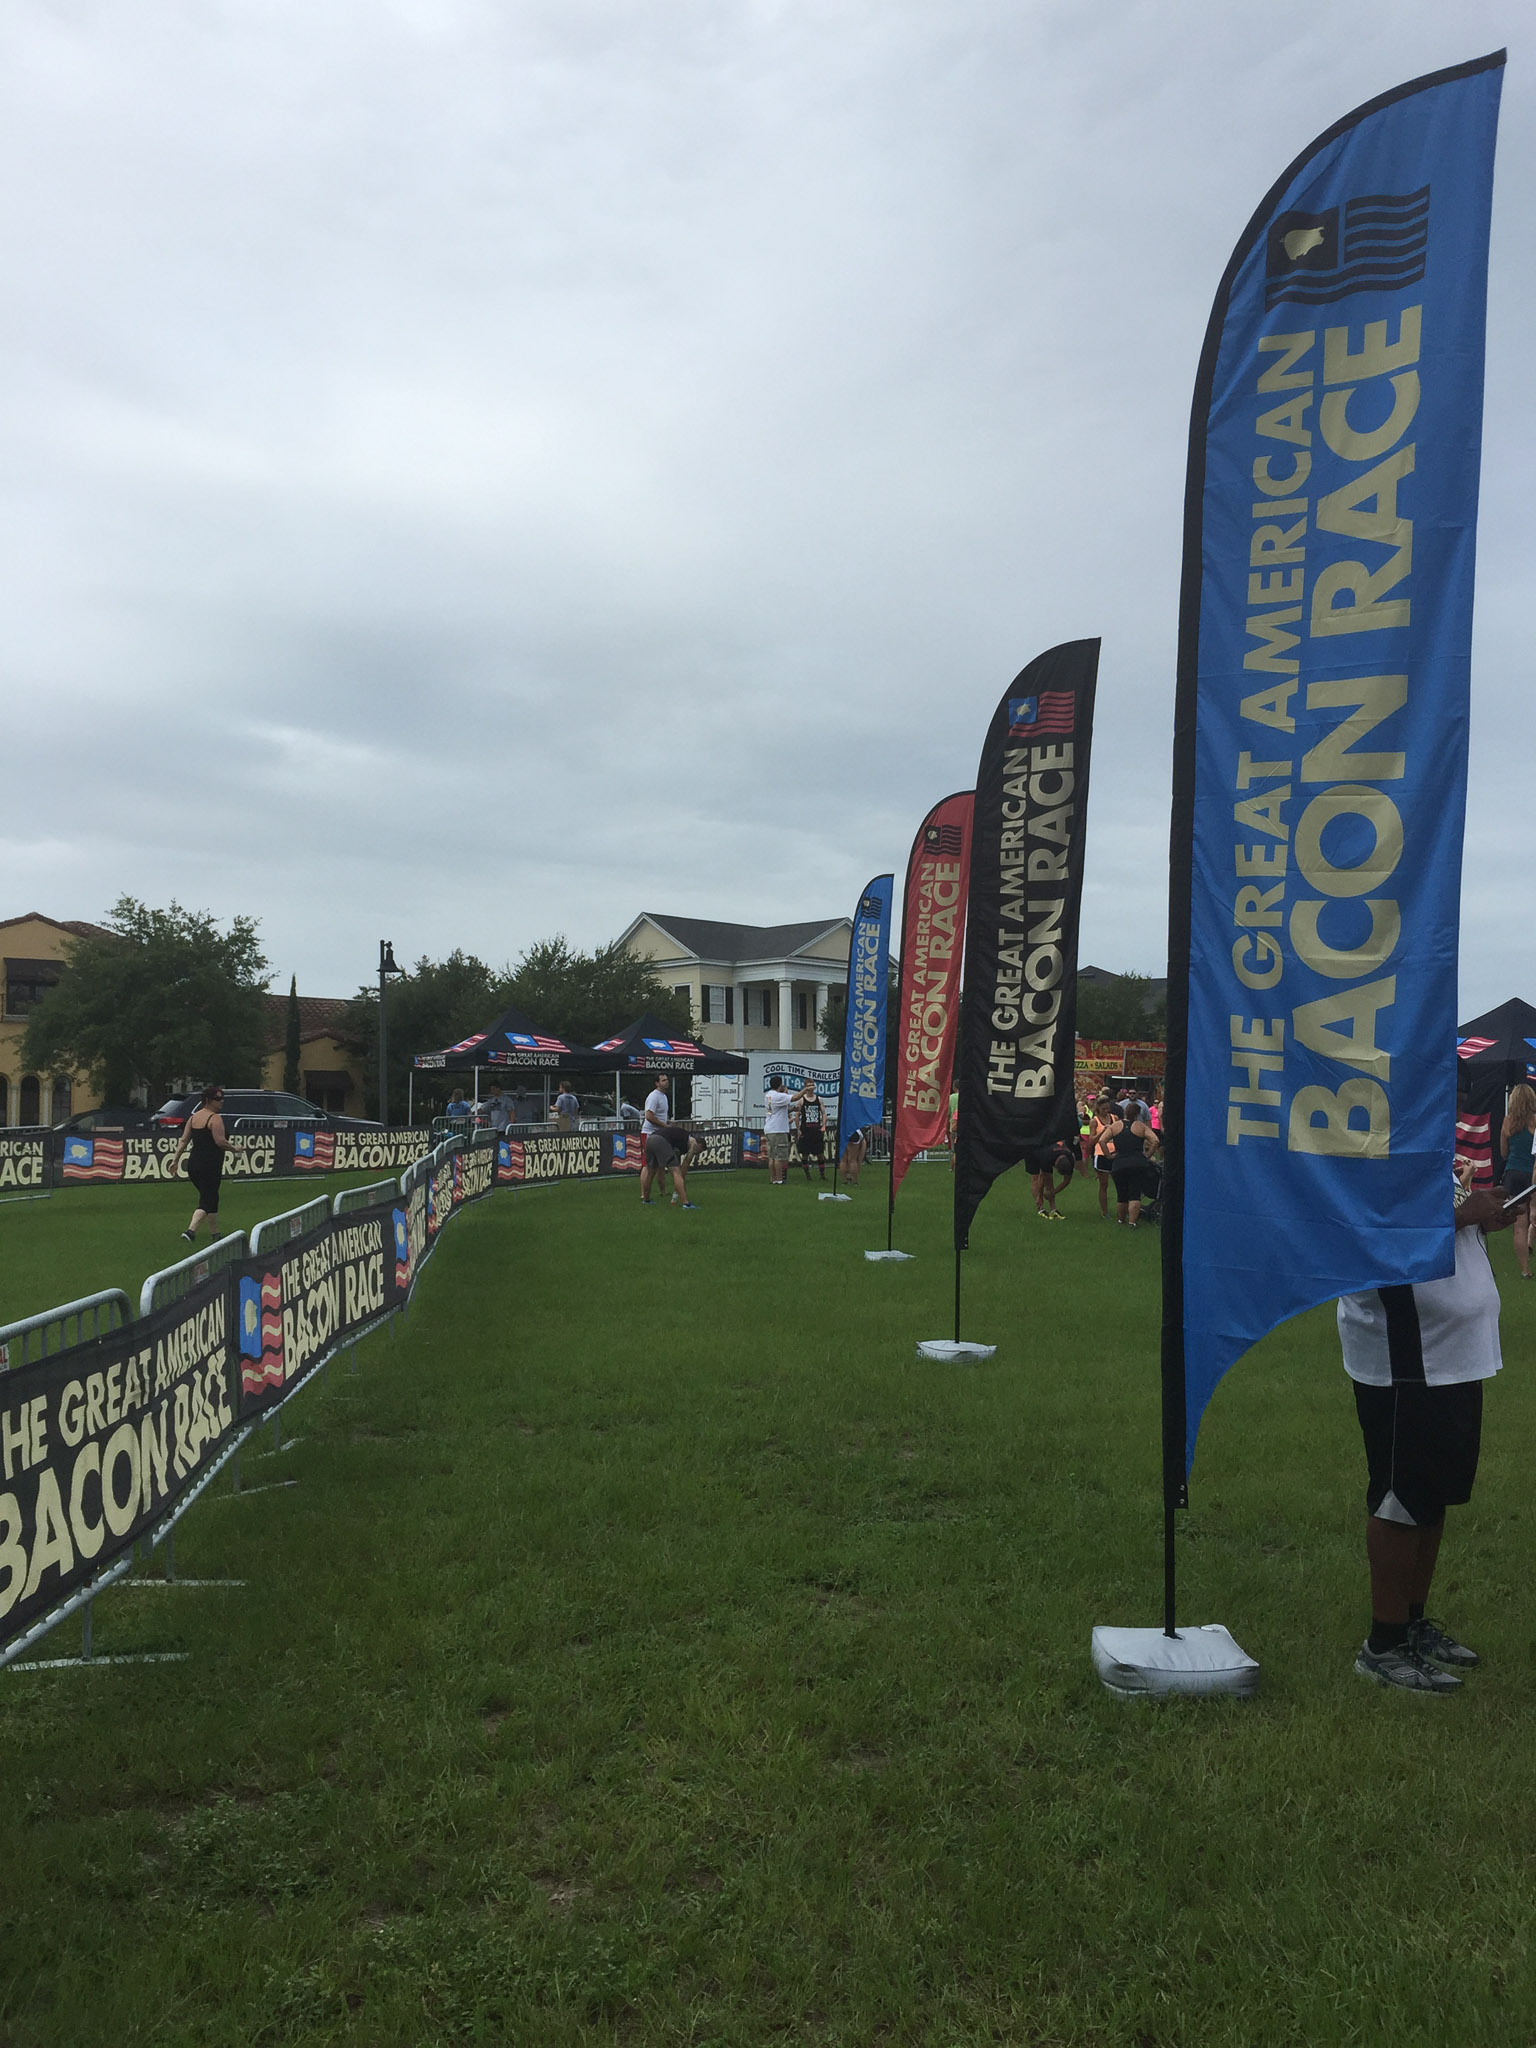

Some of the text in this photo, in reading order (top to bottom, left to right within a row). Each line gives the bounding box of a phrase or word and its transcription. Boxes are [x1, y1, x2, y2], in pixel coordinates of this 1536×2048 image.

[1226, 330, 1315, 1146] THE GREAT AMERICAN
[1287, 304, 1423, 1160] BACON RACE
[987, 747, 1028, 1096] THE GREAT AMERICAN
[1014, 742, 1075, 1098] BACON RACE
[903, 862, 936, 1109] THE GREAT AMERICAN
[916, 861, 961, 1113] BACON RACE
[850, 922, 867, 1094] THE GREAT AMERICAN
[858, 923, 881, 1099] BACON RACE
[506, 1057, 559, 1066] BACON RACE
[645, 1061, 694, 1070] BACON RACE
[765, 1064, 785, 1073] COOL
[787, 1066, 806, 1076] TIME
[1094, 1061, 1118, 1069] SALADS
[126, 1138, 152, 1153] THE
[228, 1135, 275, 1149] ERICAN
[336, 1130, 429, 1145] THE GREAT AMERICAN
[523, 1136, 600, 1153] THE GREAT AMERICAN
[704, 1133, 733, 1147] ERICAN
[0, 1156, 43, 1186] ACE
[221, 1150, 275, 1176] RACE
[334, 1143, 429, 1169] BACON RACE
[524, 1152, 566, 1179] BACON
[567, 1150, 600, 1174] RACE
[697, 1146, 732, 1166] RACE
[282, 1257, 300, 1304] THE
[302, 1236, 331, 1290] GREAT
[332, 1220, 383, 1267] AMERICAN
[283, 1252, 384, 1380] BACON RACE
[2, 1293, 225, 1480] HE GREAT AMERICAN
[0, 1345, 232, 1619] BACON RACE
